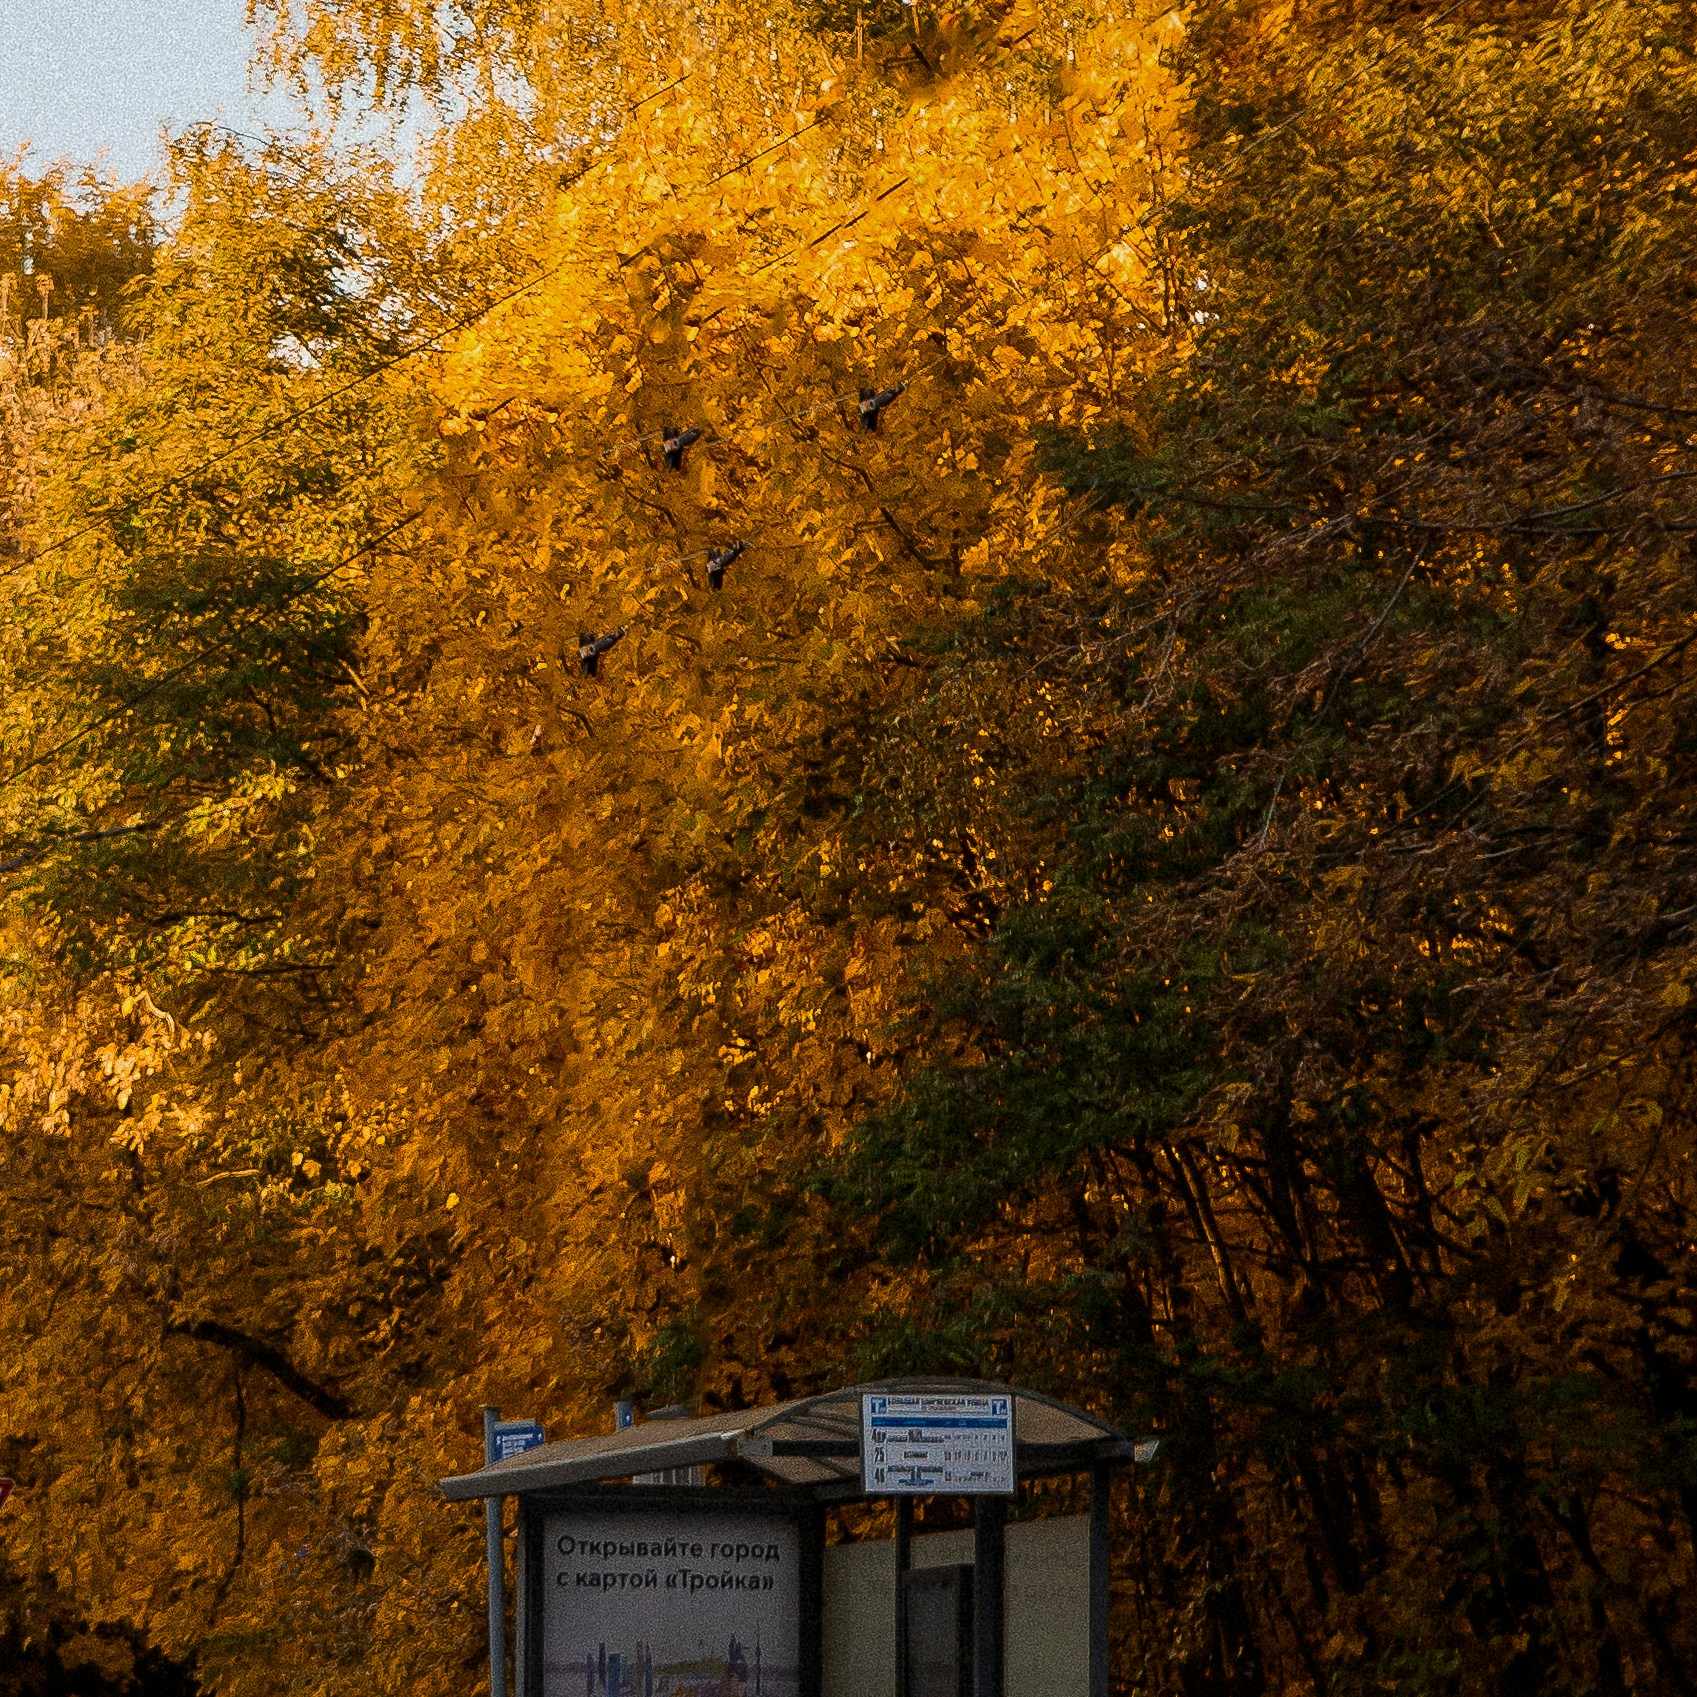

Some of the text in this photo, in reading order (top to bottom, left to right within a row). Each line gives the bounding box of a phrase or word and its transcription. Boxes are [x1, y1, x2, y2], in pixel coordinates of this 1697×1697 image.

[556, 1535, 781, 1562] Открывайте город
[556, 1569, 775, 1595] с картой «Тройка»
